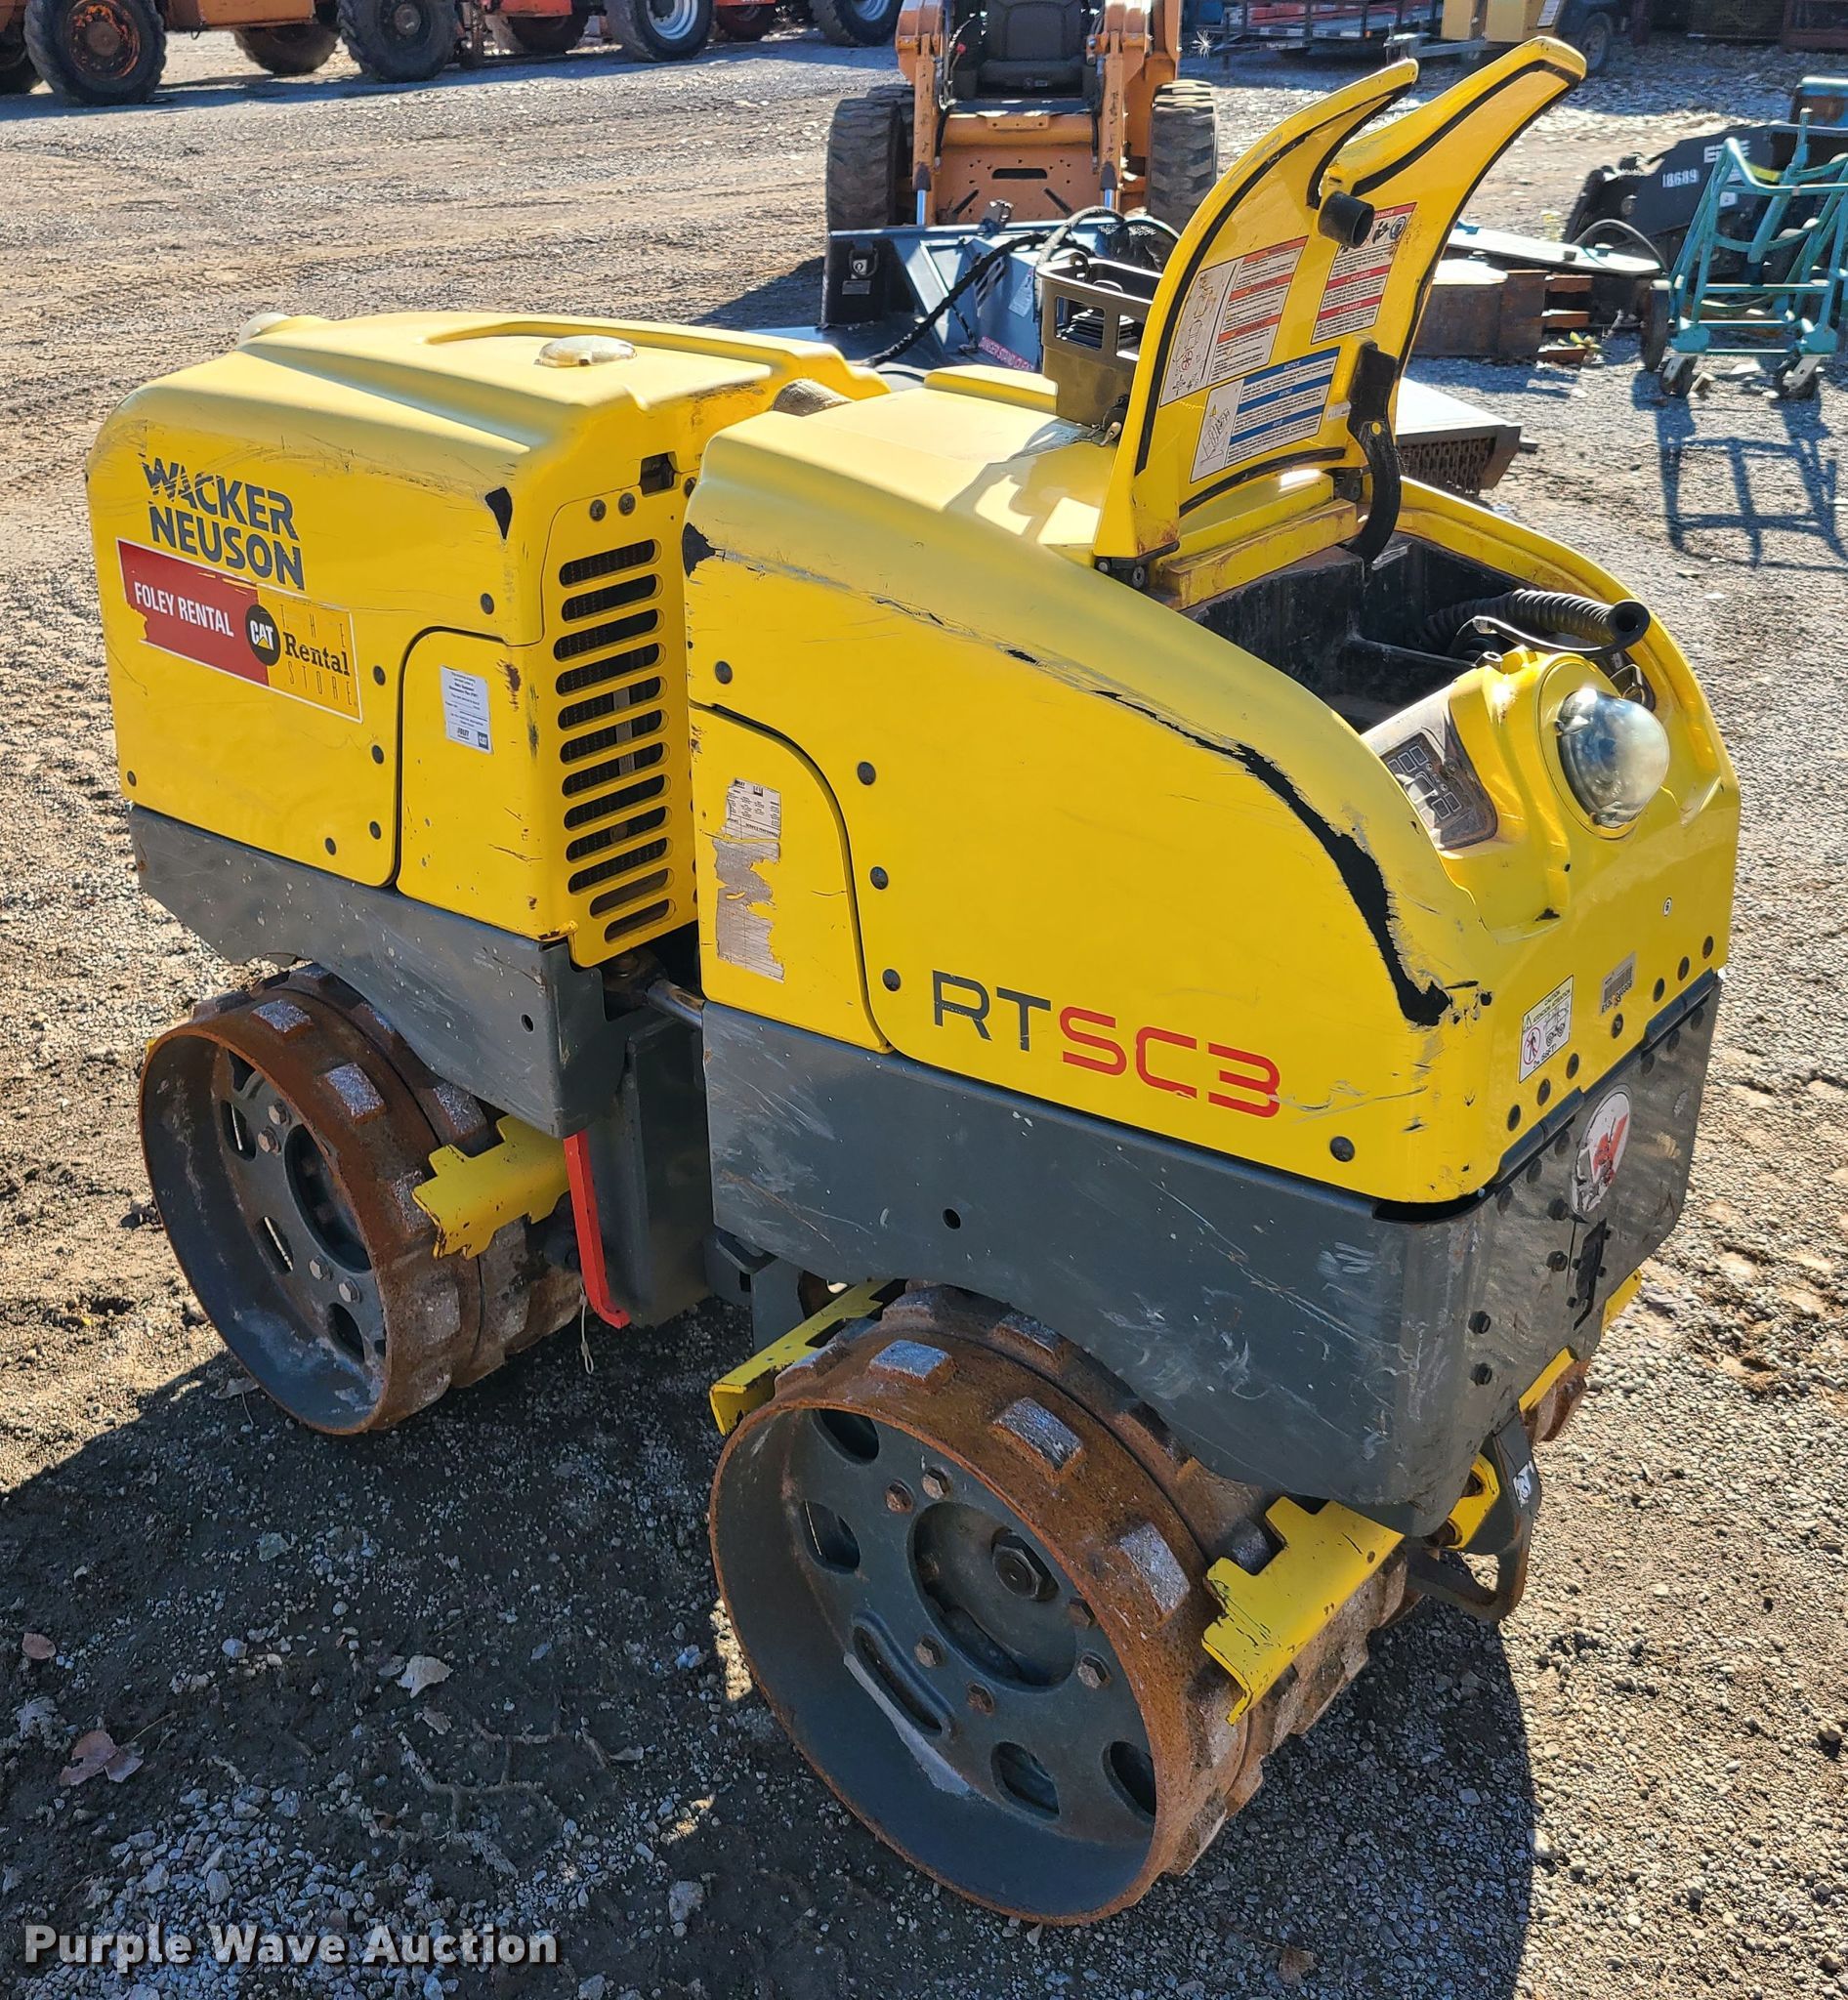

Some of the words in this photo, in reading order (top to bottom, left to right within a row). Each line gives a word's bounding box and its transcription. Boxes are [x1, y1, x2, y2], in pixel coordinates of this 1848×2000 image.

[1662, 169, 1700, 188] 18689
[141, 452, 300, 541] WACKER
[148, 499, 306, 591] NEUSON
[133, 580, 176, 617] FOLEY
[178, 596, 234, 638] RENTAL
[278, 604, 346, 649] THE
[249, 618, 274, 651] CAT
[283, 630, 351, 677] Rental
[288, 662, 353, 706] STORE
[932, 969, 1281, 1119] RTSC3
